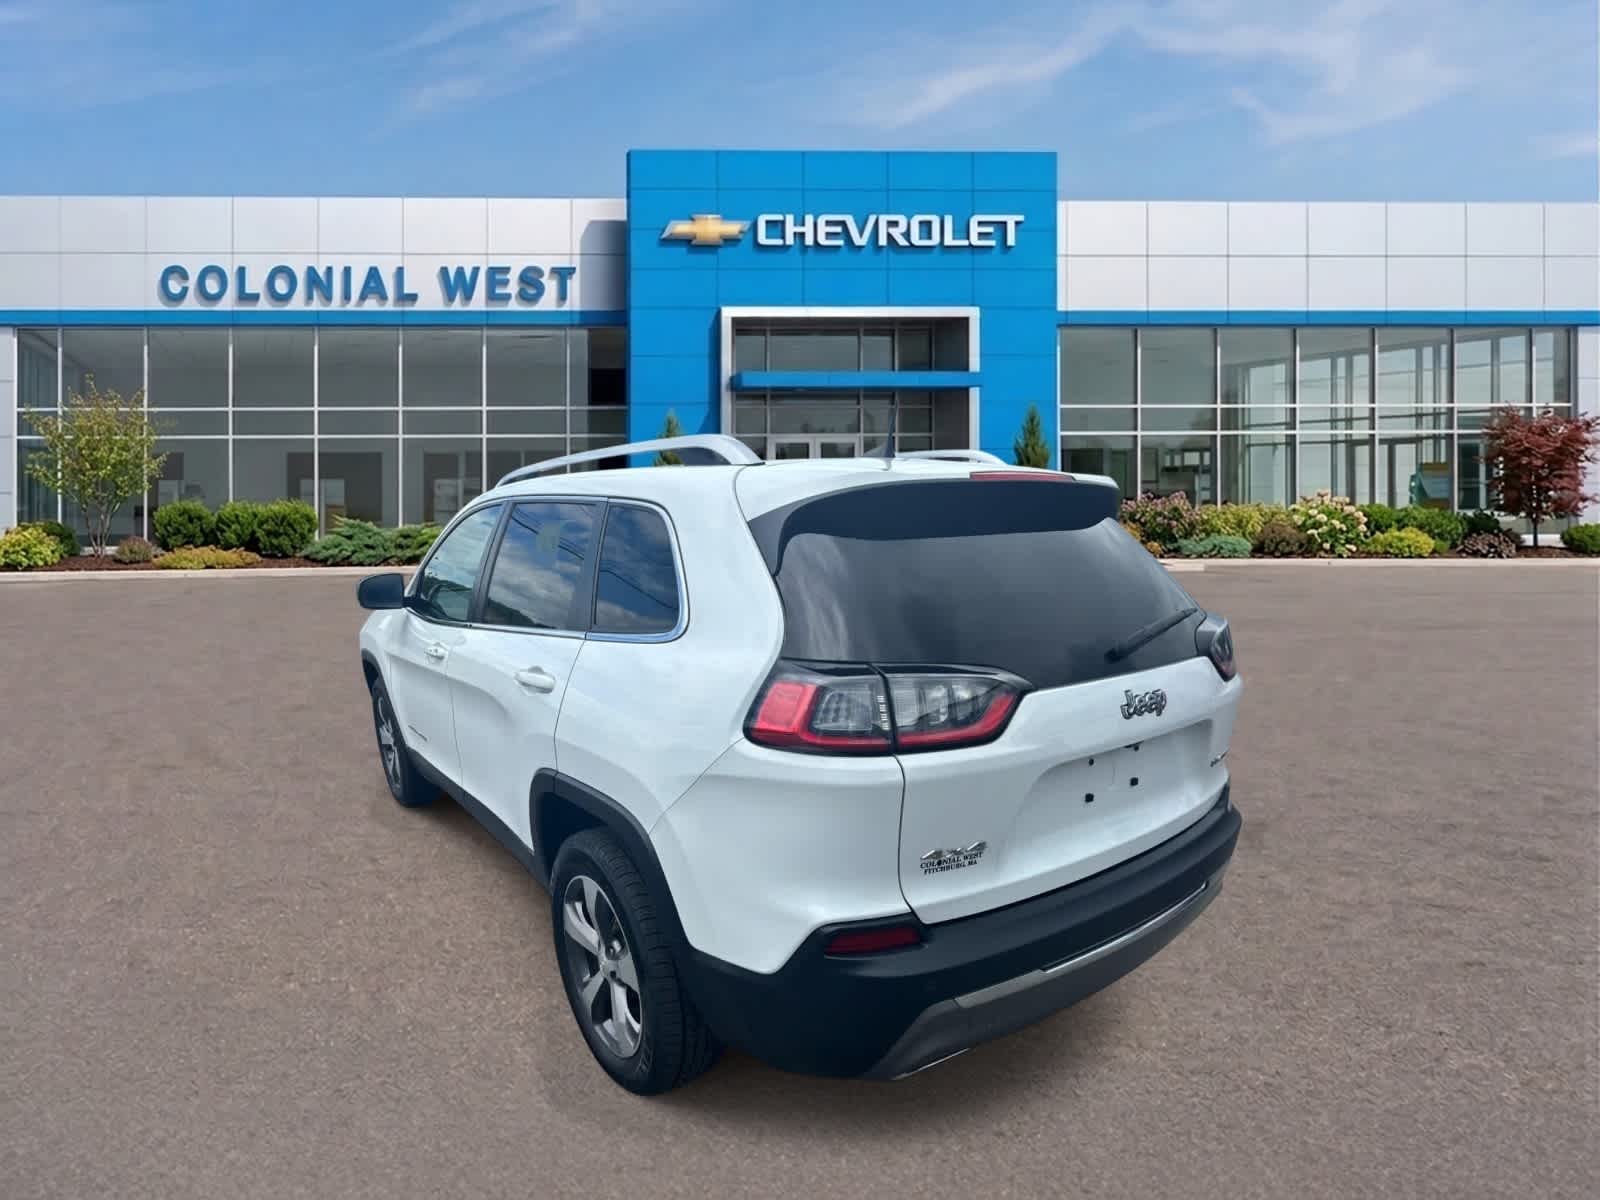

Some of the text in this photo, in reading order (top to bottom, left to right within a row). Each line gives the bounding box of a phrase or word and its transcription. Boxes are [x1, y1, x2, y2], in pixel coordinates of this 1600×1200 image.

[756, 213, 1025, 248] CHEVROLET
[159, 264, 577, 308] COLONIAL WEST
[1120, 688, 1167, 720] Jeep
[920, 851, 983, 869] COLONIAL WEST
